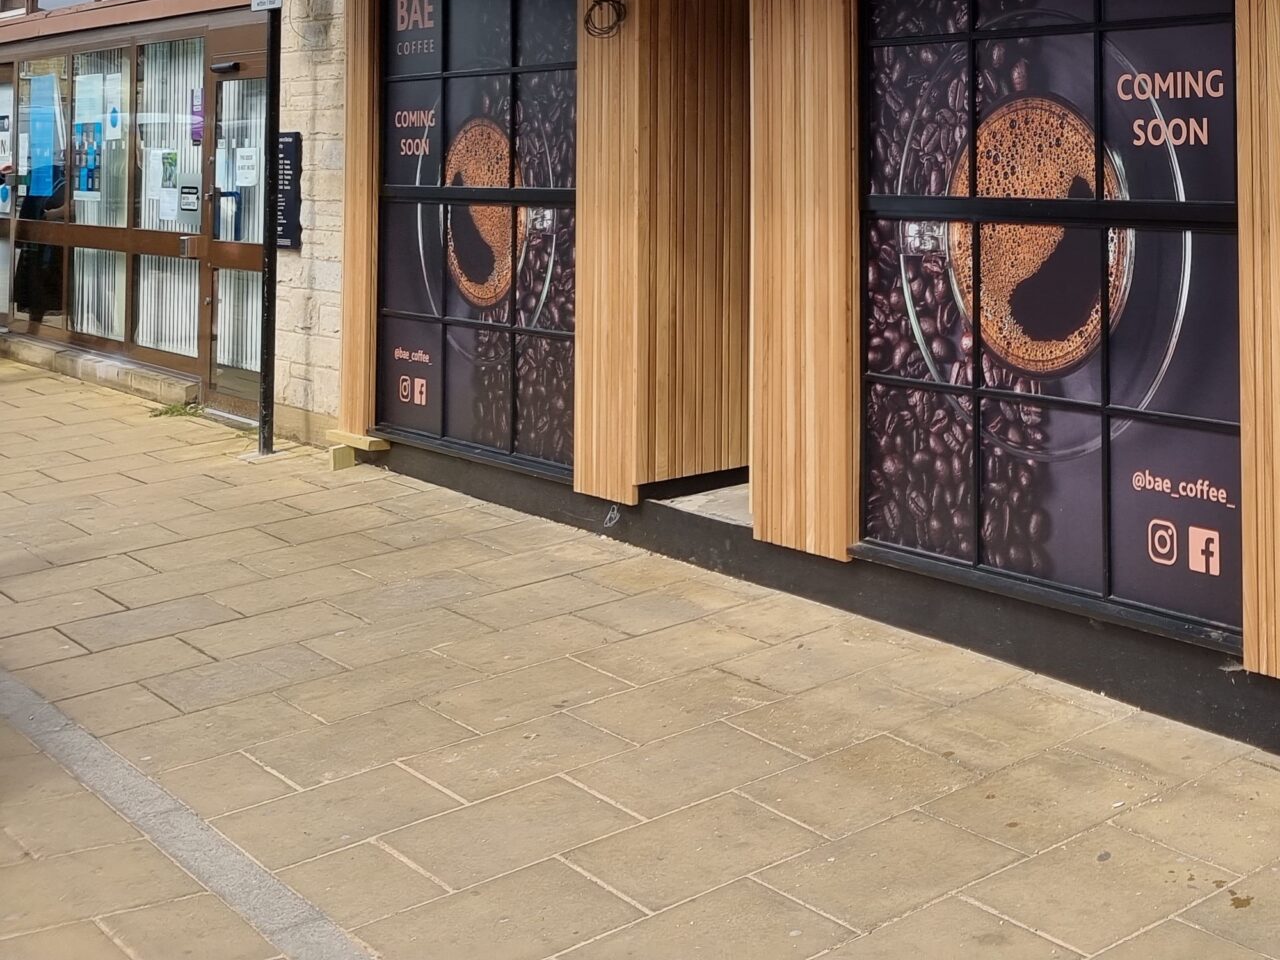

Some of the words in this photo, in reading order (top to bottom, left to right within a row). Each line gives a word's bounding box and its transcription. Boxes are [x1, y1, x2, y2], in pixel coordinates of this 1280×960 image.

[397, 40, 435, 56] COFFEE
[1116, 69, 1225, 101] COMING
[394, 110, 436, 128] COMING
[1132, 117, 1209, 147] SOON
[400, 138, 430, 156] SOON
[1132, 469, 1236, 508] @bae_coffee_
